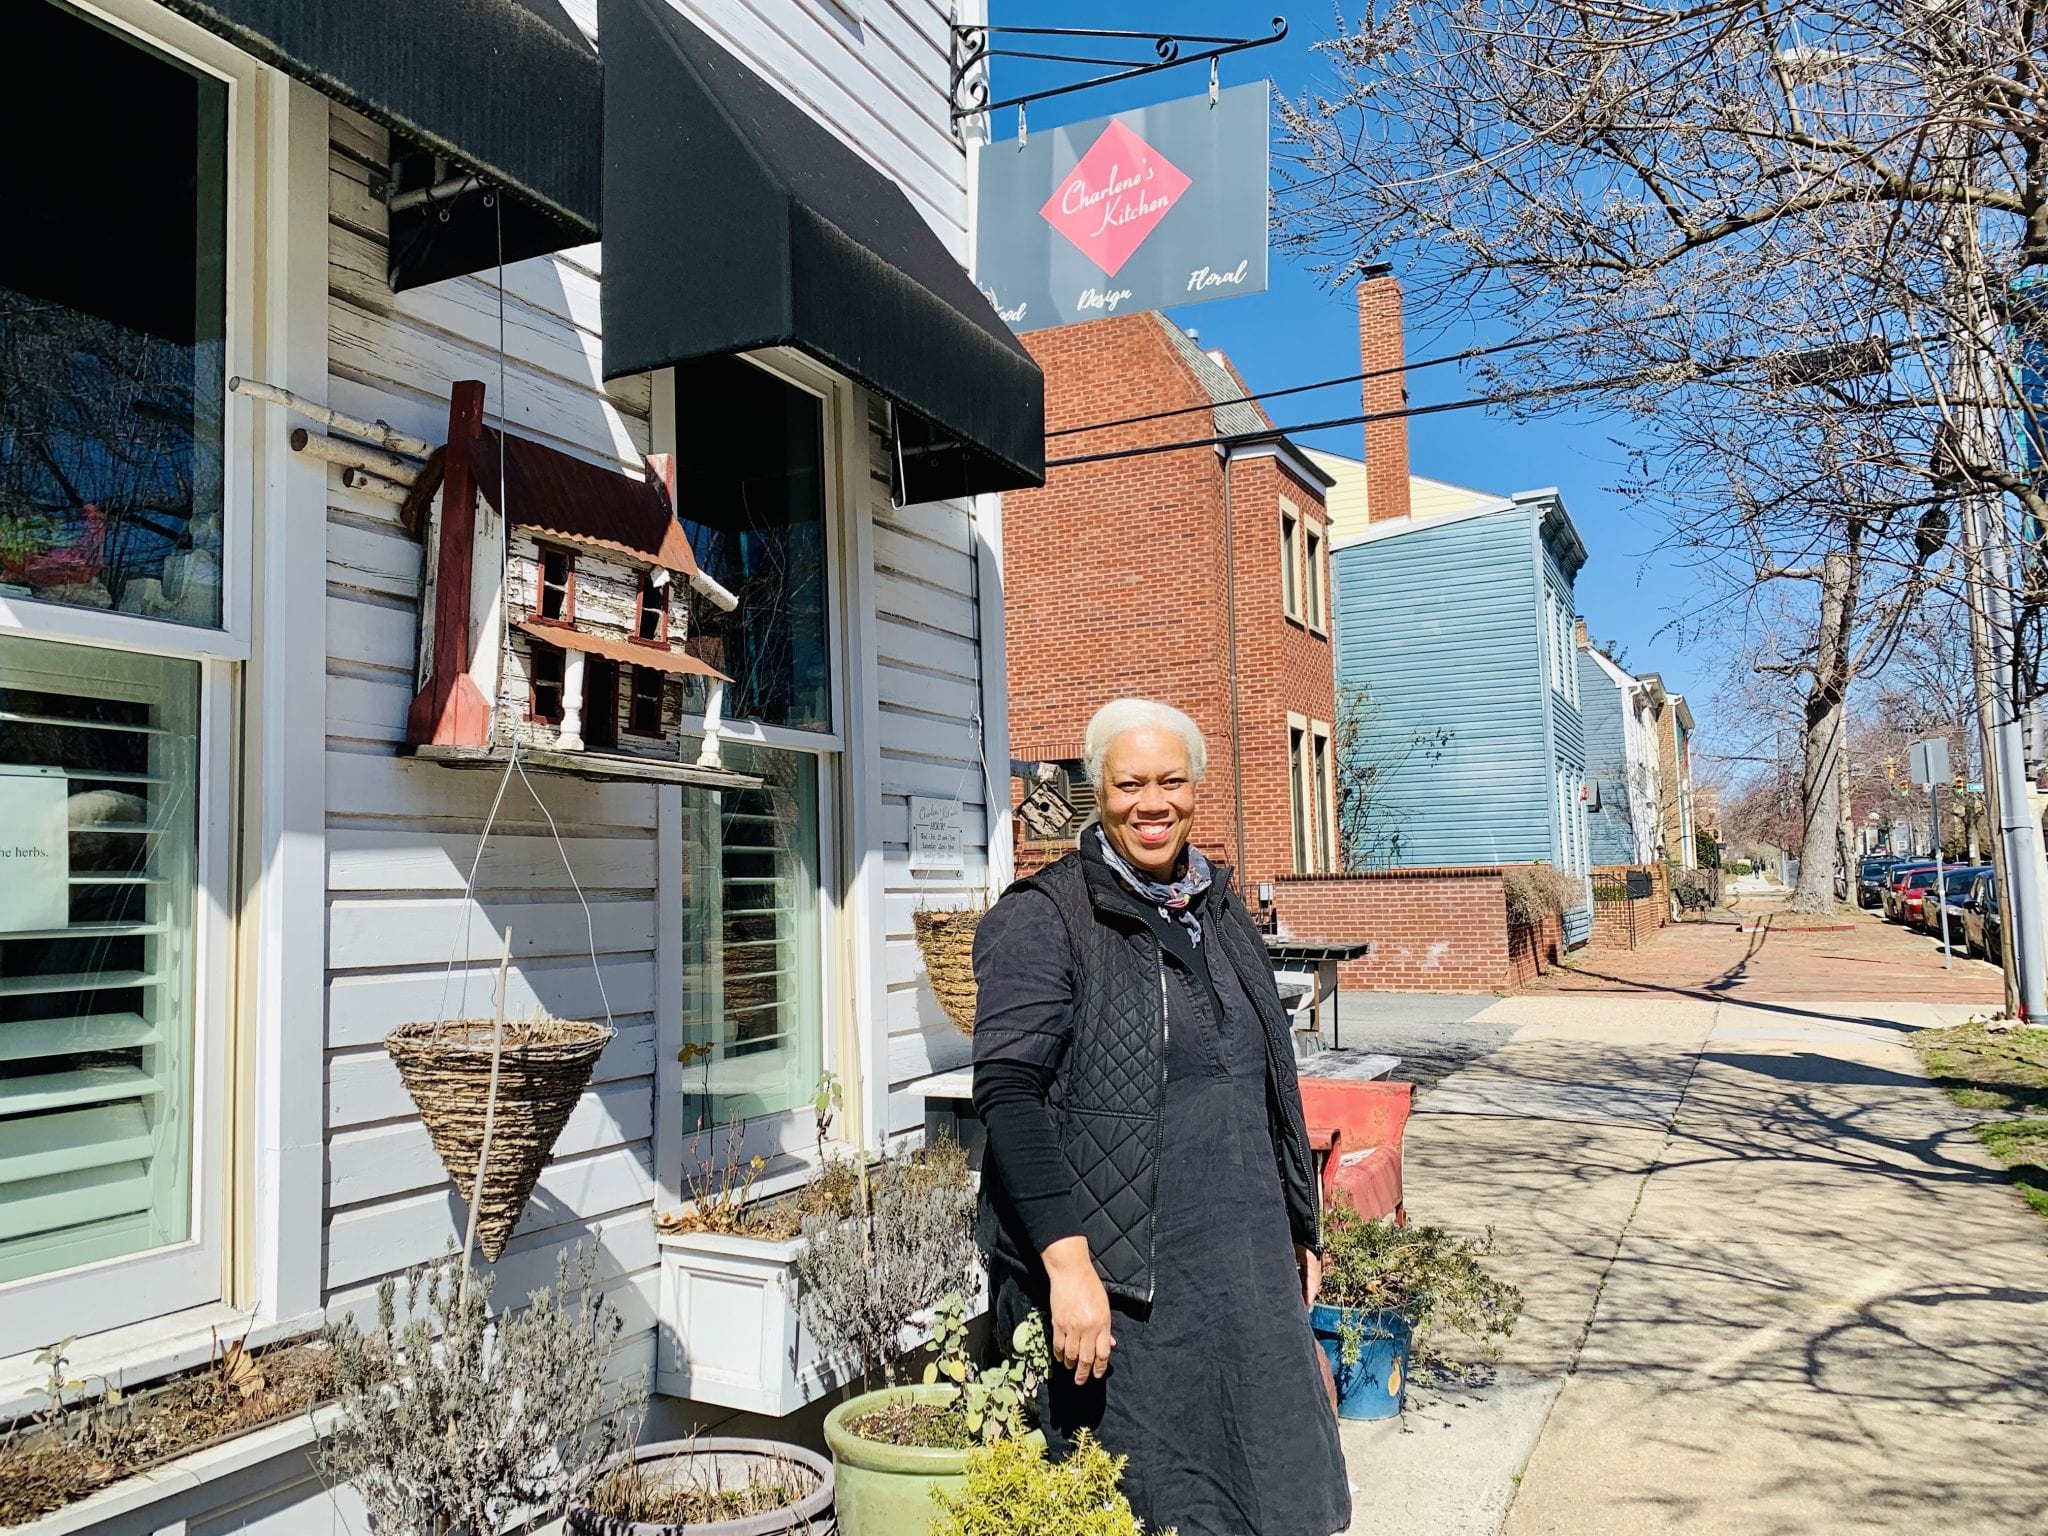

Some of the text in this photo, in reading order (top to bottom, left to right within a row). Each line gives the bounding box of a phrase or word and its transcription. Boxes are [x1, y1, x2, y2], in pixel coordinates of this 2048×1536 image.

[1062, 158, 1154, 215] Charlene's
[1089, 190, 1169, 237] Kitchen
[997, 260, 1248, 322] ood Design Floral
[15, 847, 49, 858] herbs.
